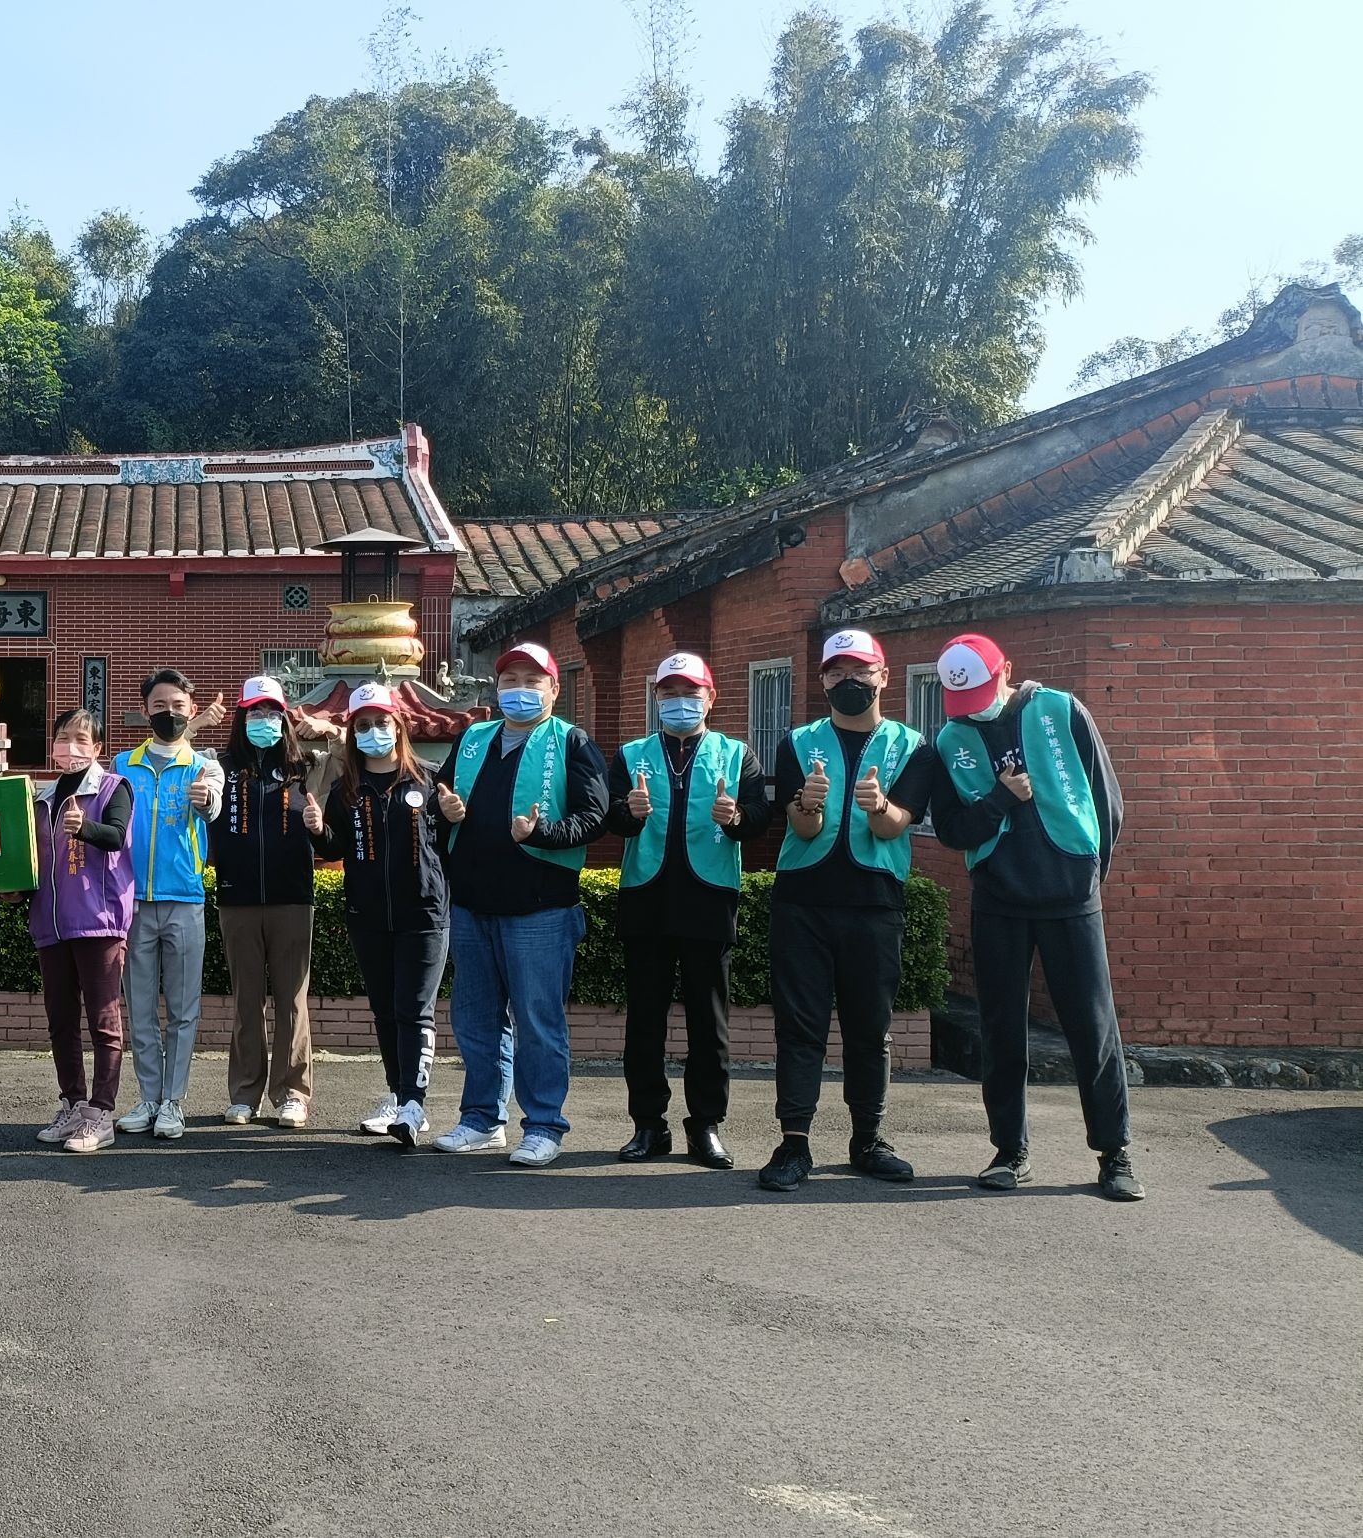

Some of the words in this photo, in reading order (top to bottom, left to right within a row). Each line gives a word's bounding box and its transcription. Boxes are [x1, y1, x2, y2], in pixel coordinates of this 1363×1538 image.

[87, 666, 102, 718] 東海家
[952, 747, 977, 770] 志
[416, 1027, 436, 1089] FILA
